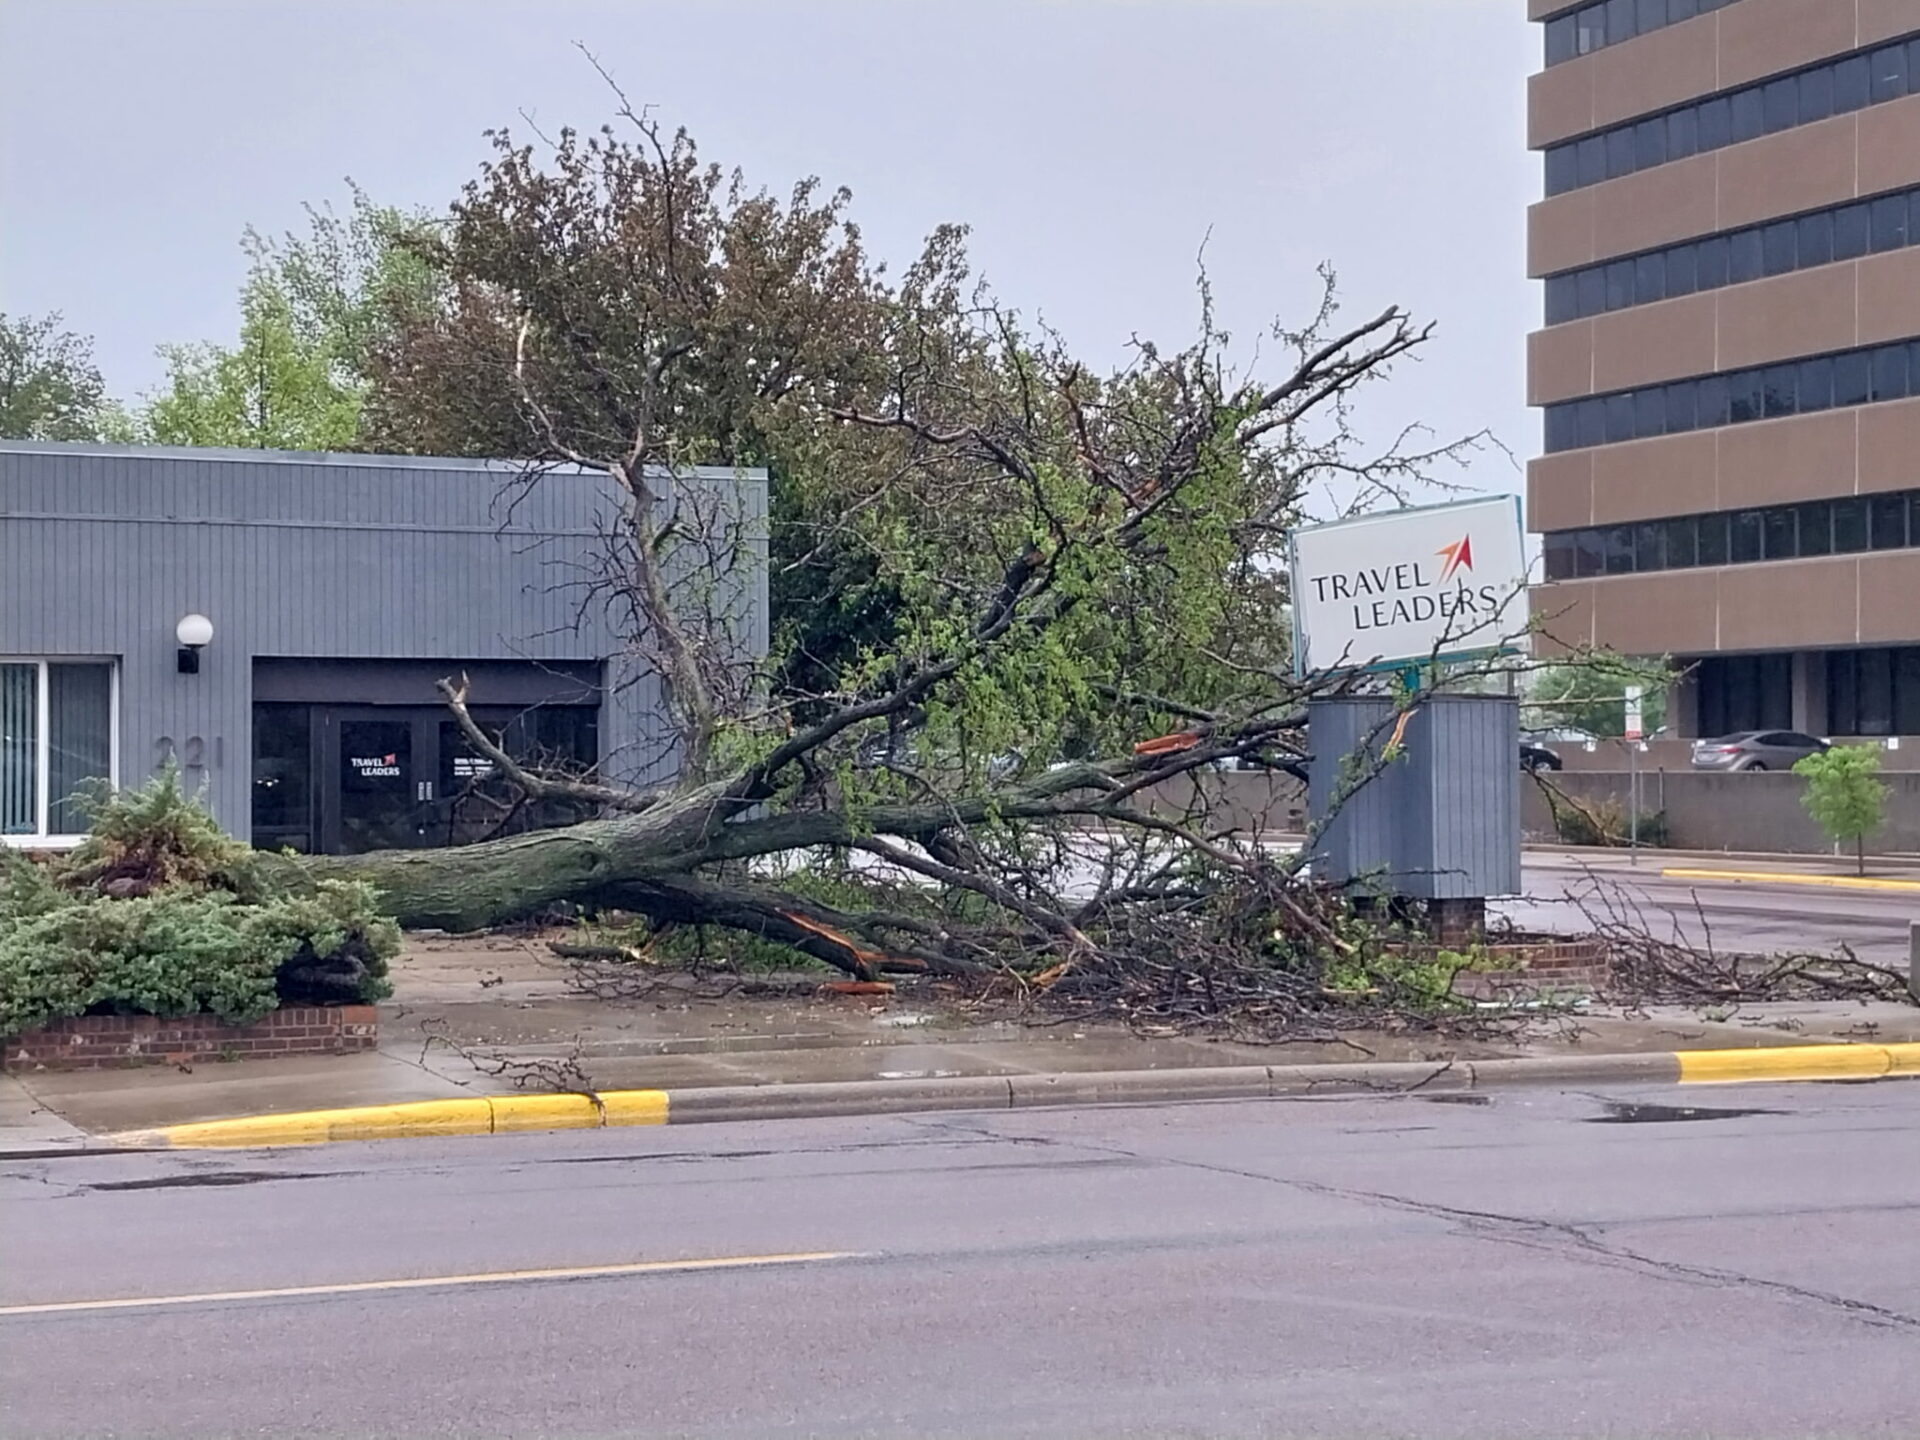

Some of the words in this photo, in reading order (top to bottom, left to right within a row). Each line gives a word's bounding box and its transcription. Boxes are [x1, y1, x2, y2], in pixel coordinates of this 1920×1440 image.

[1311, 562, 1431, 602] TRAVEL
[1353, 585, 1498, 630] LEADERS
[155, 736, 223, 769] 221
[351, 758, 384, 767] TRAVEL
[361, 767, 400, 776] LEADERS
